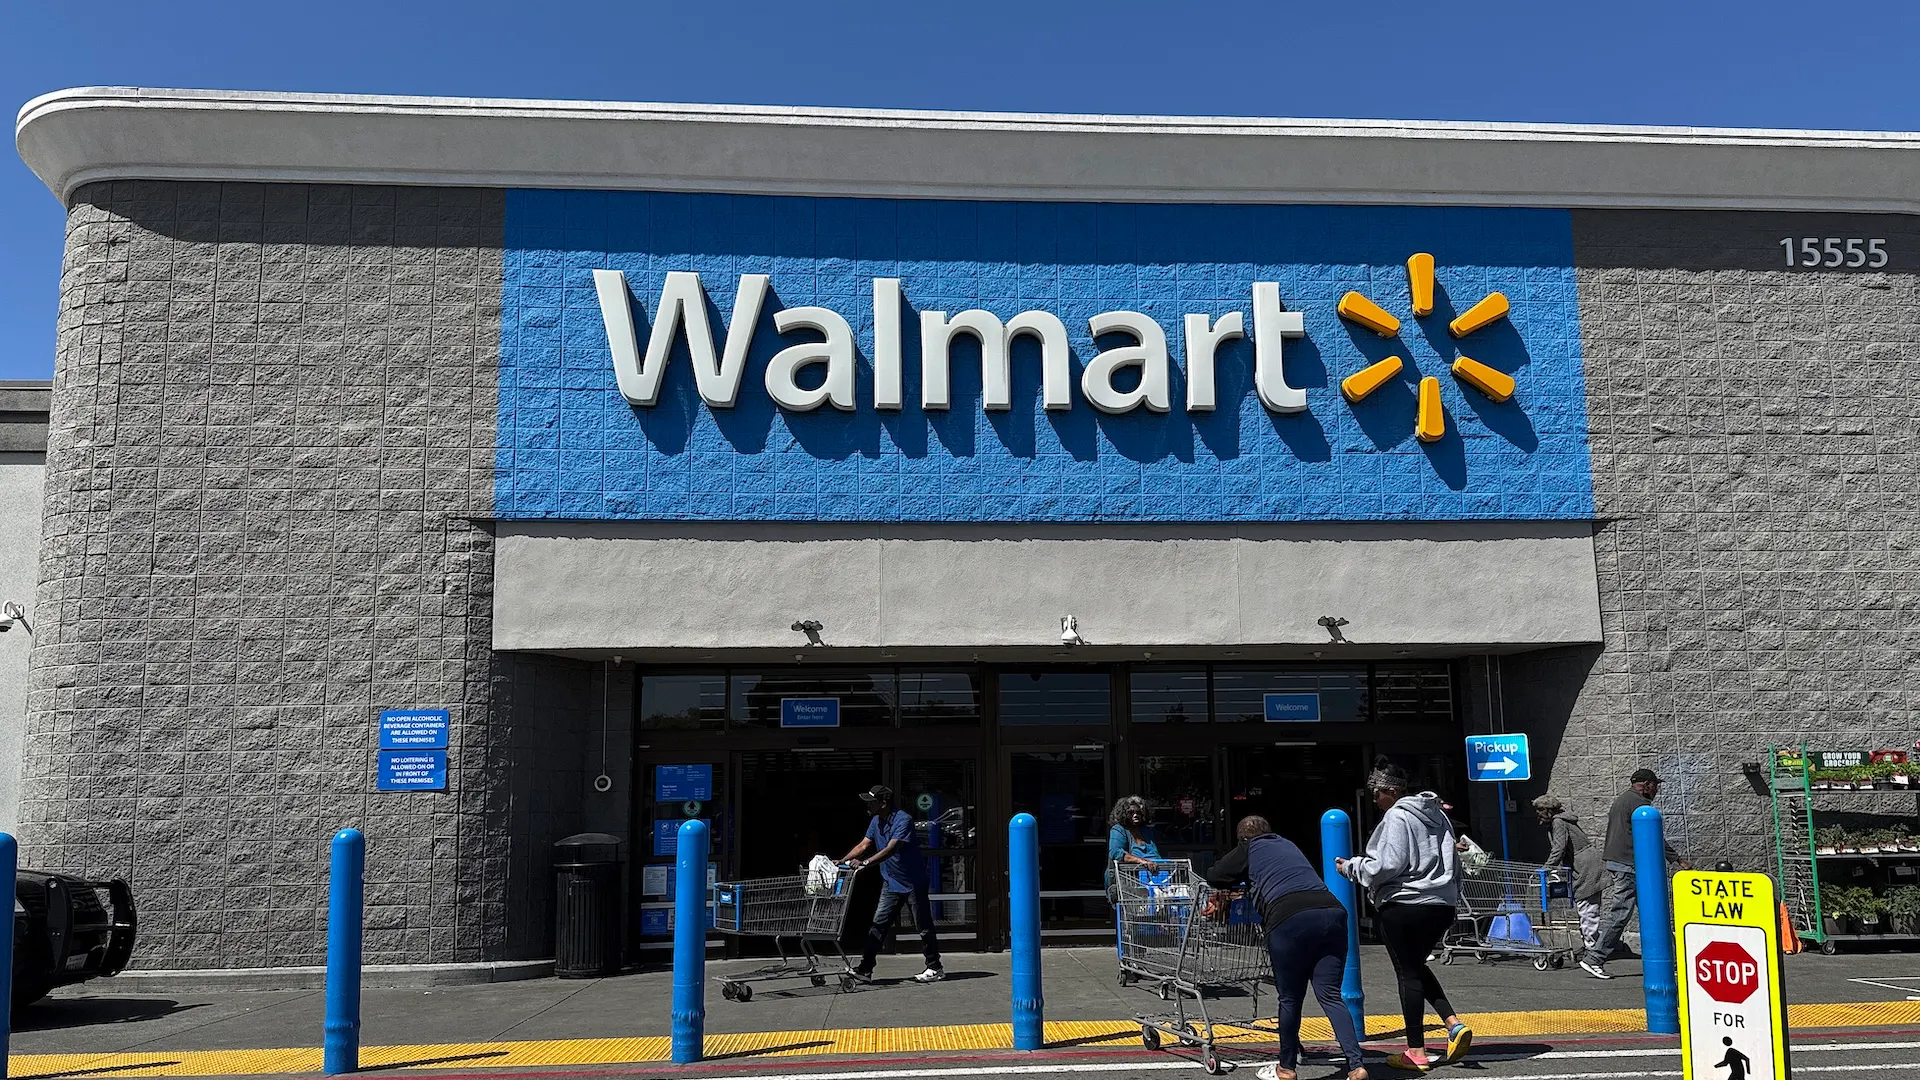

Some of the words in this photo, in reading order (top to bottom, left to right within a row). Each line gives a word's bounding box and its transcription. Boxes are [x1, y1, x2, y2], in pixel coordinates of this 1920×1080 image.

[1779, 237, 1888, 268] 15555
[592, 268, 1308, 415] Walmart
[792, 704, 828, 713] Welcome
[1275, 703, 1309, 711] Welcome
[1474, 741, 1519, 755] Pickup
[1822, 752, 1842, 760] GROW
[1843, 752, 1861, 760] YOUR
[1824, 759, 1861, 767] GROCERIES
[1691, 878, 1754, 898] STATE
[1701, 901, 1743, 919] LAW
[1698, 958, 1755, 986] STOP
[1713, 1012, 1745, 1028] FOR
